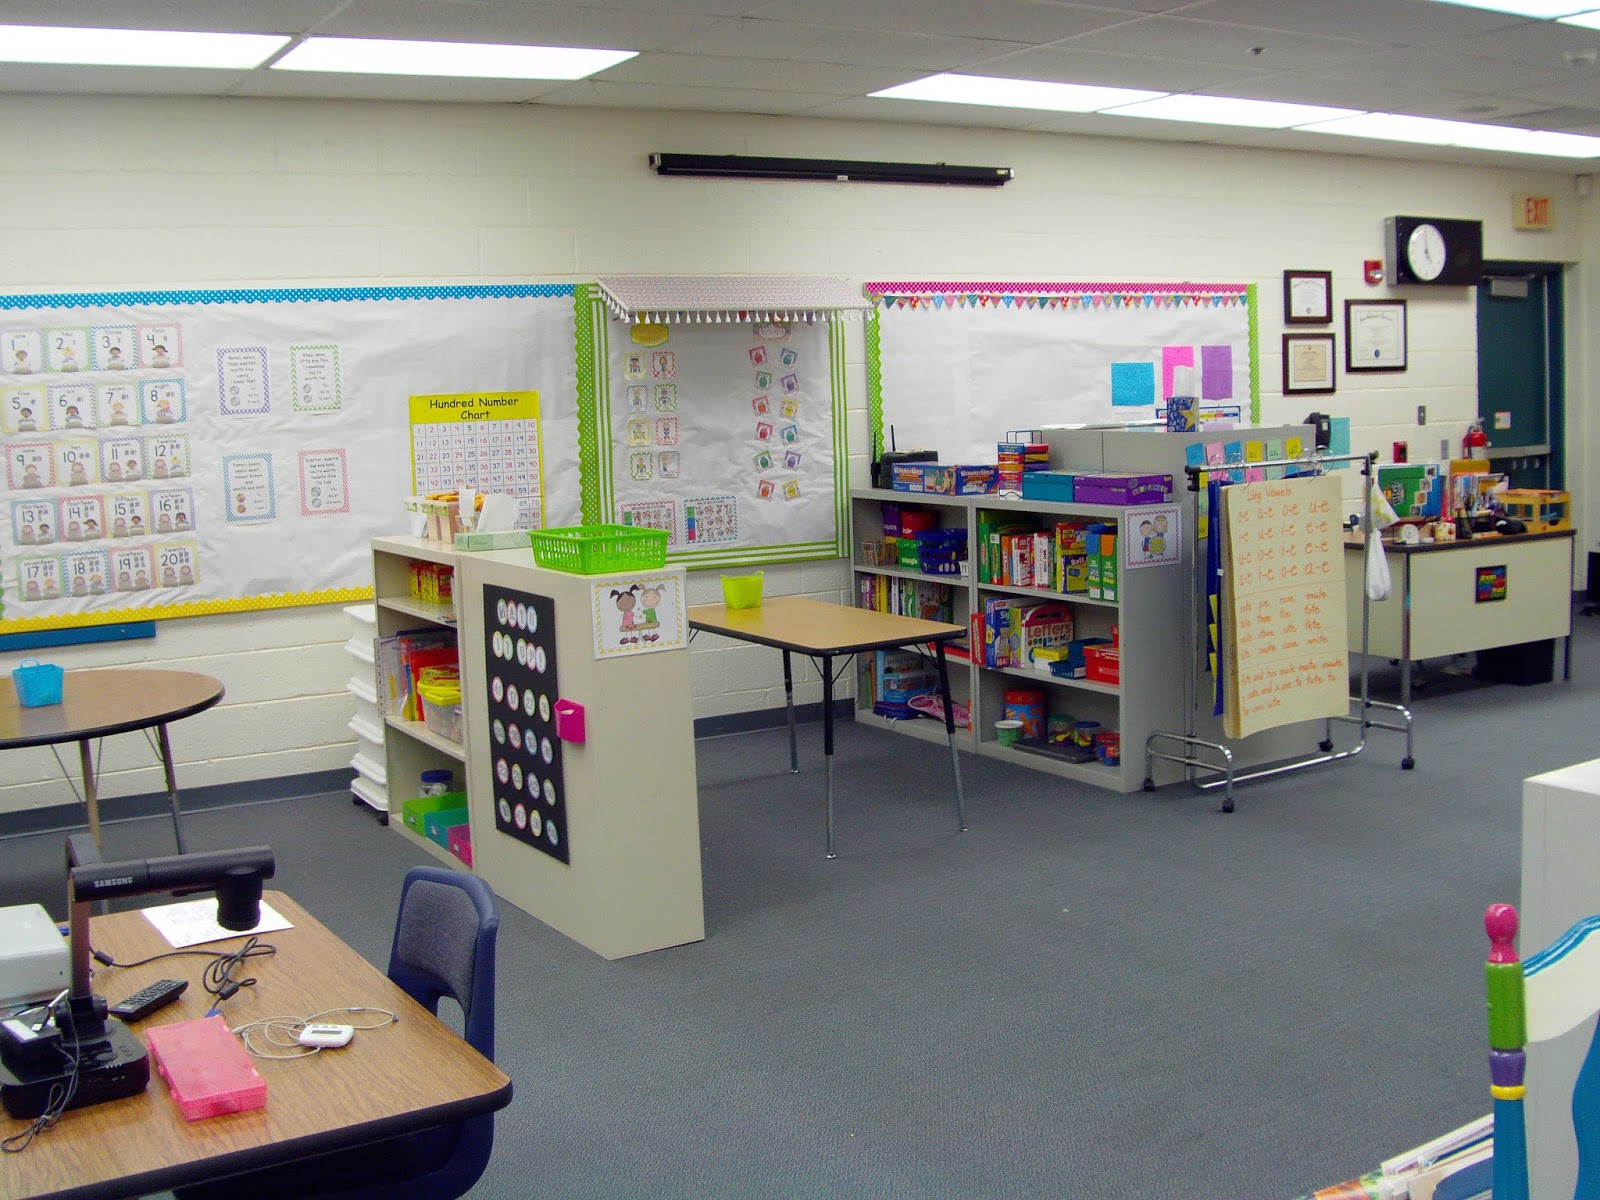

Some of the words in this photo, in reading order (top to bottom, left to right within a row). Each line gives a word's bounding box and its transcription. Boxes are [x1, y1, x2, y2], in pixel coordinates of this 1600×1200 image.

[1526, 197, 1548, 225] EXIT
[56, 338, 64, 350] 2
[102, 336, 110, 348] 3
[147, 334, 155, 345] 4
[59, 395, 67, 407] 6
[106, 392, 113, 404] 7
[150, 390, 158, 402] 8
[13, 397, 20, 410] 5
[430, 398, 474, 409] Hundred
[479, 397, 518, 407] Number
[461, 410, 490, 420] Chart
[111, 448, 118, 460] 11
[155, 445, 166, 456] 12
[17, 455, 25, 466] 9
[63, 451, 76, 463] 10
[1266, 486, 1292, 498] Vowels
[1391, 486, 1400, 505] BIG
[114, 503, 126, 515] 15
[159, 500, 171, 511] 16
[22, 511, 34, 522] 13
[68, 507, 81, 519] 14
[119, 558, 131, 570] 19
[161, 554, 178, 566] 20
[26, 566, 39, 578] 17
[74, 562, 85, 574] 18
[498, 601, 536, 630] MATH
[1028, 623, 1071, 638] Letters
[94, 876, 133, 888] SAMSUNG
